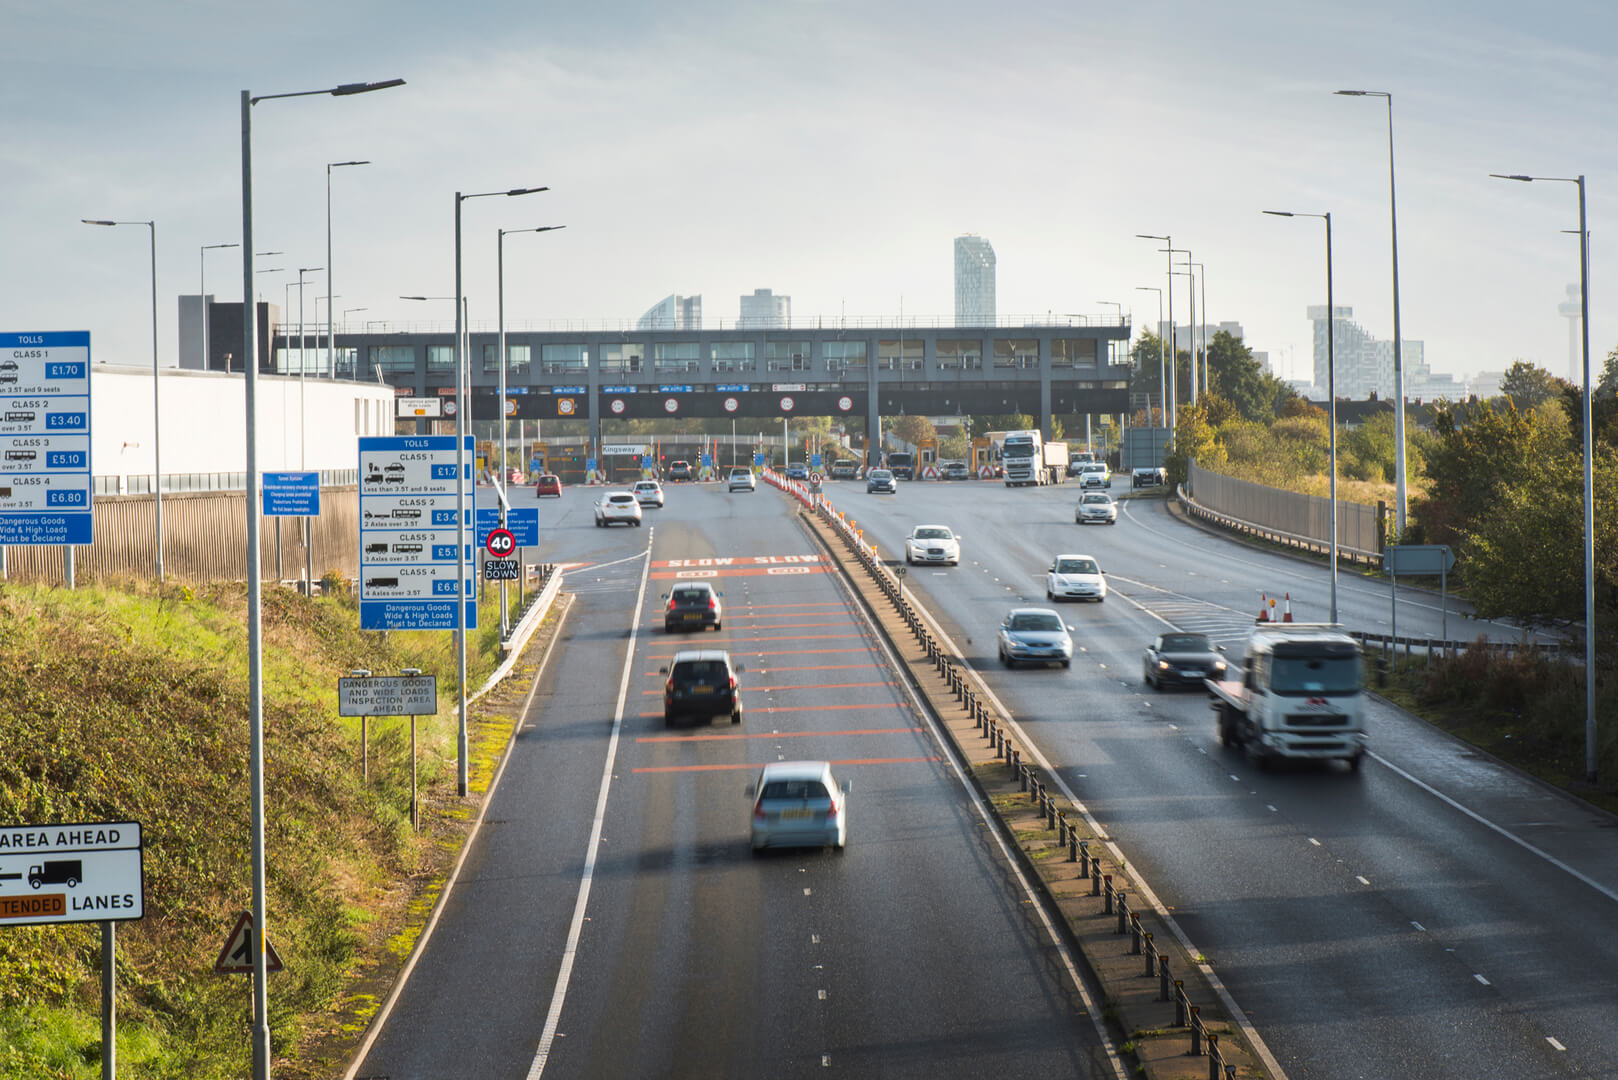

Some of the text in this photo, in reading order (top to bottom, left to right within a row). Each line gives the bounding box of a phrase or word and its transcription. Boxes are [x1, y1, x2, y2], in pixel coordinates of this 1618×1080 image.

[18, 335, 44, 344] TOLLS
[13, 350, 49, 359] CLASS 1
[52, 365, 78, 376] £1.70
[12, 400, 49, 409] CLASS 2
[51, 416, 81, 426] £3.40
[13, 439, 50, 447] CLASS 3
[404, 440, 429, 448] TOLLS
[603, 446, 636, 454] Kingsway
[52, 454, 80, 464] £5.10
[400, 453, 427, 461] CLASS
[438, 467, 457, 476] £1.7
[13, 478, 41, 486] CLASS
[51, 493, 81, 503] £6.80
[40, 517, 66, 525] Goods
[436, 513, 457, 522] £3.4
[25, 526, 43, 535] High
[45, 526, 68, 534] Loads
[0, 533, 66, 542] Must be Declared
[491, 536, 512, 549] 40
[438, 548, 457, 557] £5.1
[668, 555, 819, 567] SLOW SLOW
[486, 570, 517, 578] DOWN
[437, 583, 458, 592] £6.8
[385, 604, 451, 615] Dangerous Goods
[384, 613, 403, 621] Wide
[412, 613, 430, 622] High
[432, 612, 453, 620] Loads
[387, 620, 451, 629] Must be Declared
[343, 681, 399, 689] DANGEROUS
[349, 689, 369, 697] AND
[400, 688, 430, 696] LOADS
[348, 697, 403, 705] INSPECTION
[373, 705, 404, 713] AHEAD
[0, 829, 120, 848] AREA AHEAD
[1, 893, 134, 914] TENDED LANES
